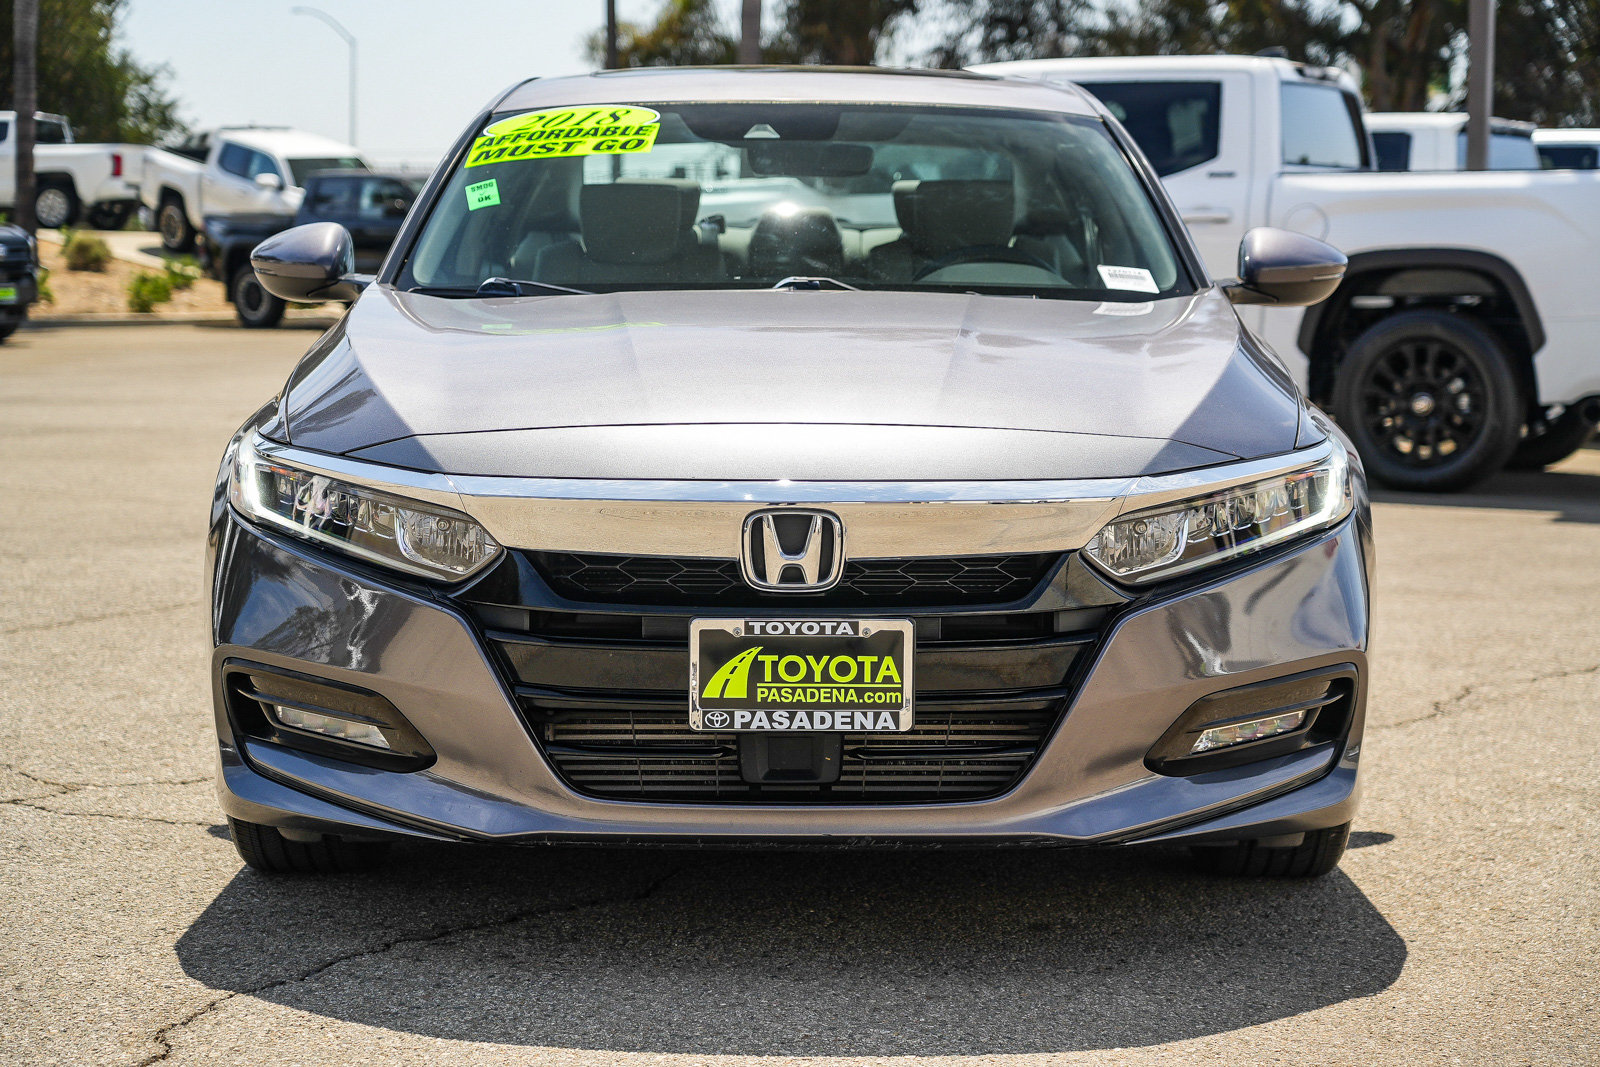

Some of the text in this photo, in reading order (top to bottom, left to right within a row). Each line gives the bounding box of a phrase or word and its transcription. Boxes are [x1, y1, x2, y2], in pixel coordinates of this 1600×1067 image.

[511, 109, 631, 132] 2018
[476, 124, 654, 150] AFFORDABLE
[471, 138, 647, 164] MUST GO
[478, 195, 491, 203] OK
[749, 621, 854, 635] TOYOTA
[757, 654, 902, 683] TOYOTA
[757, 688, 902, 703] PASADENA.com
[734, 710, 897, 730] PASADENA
